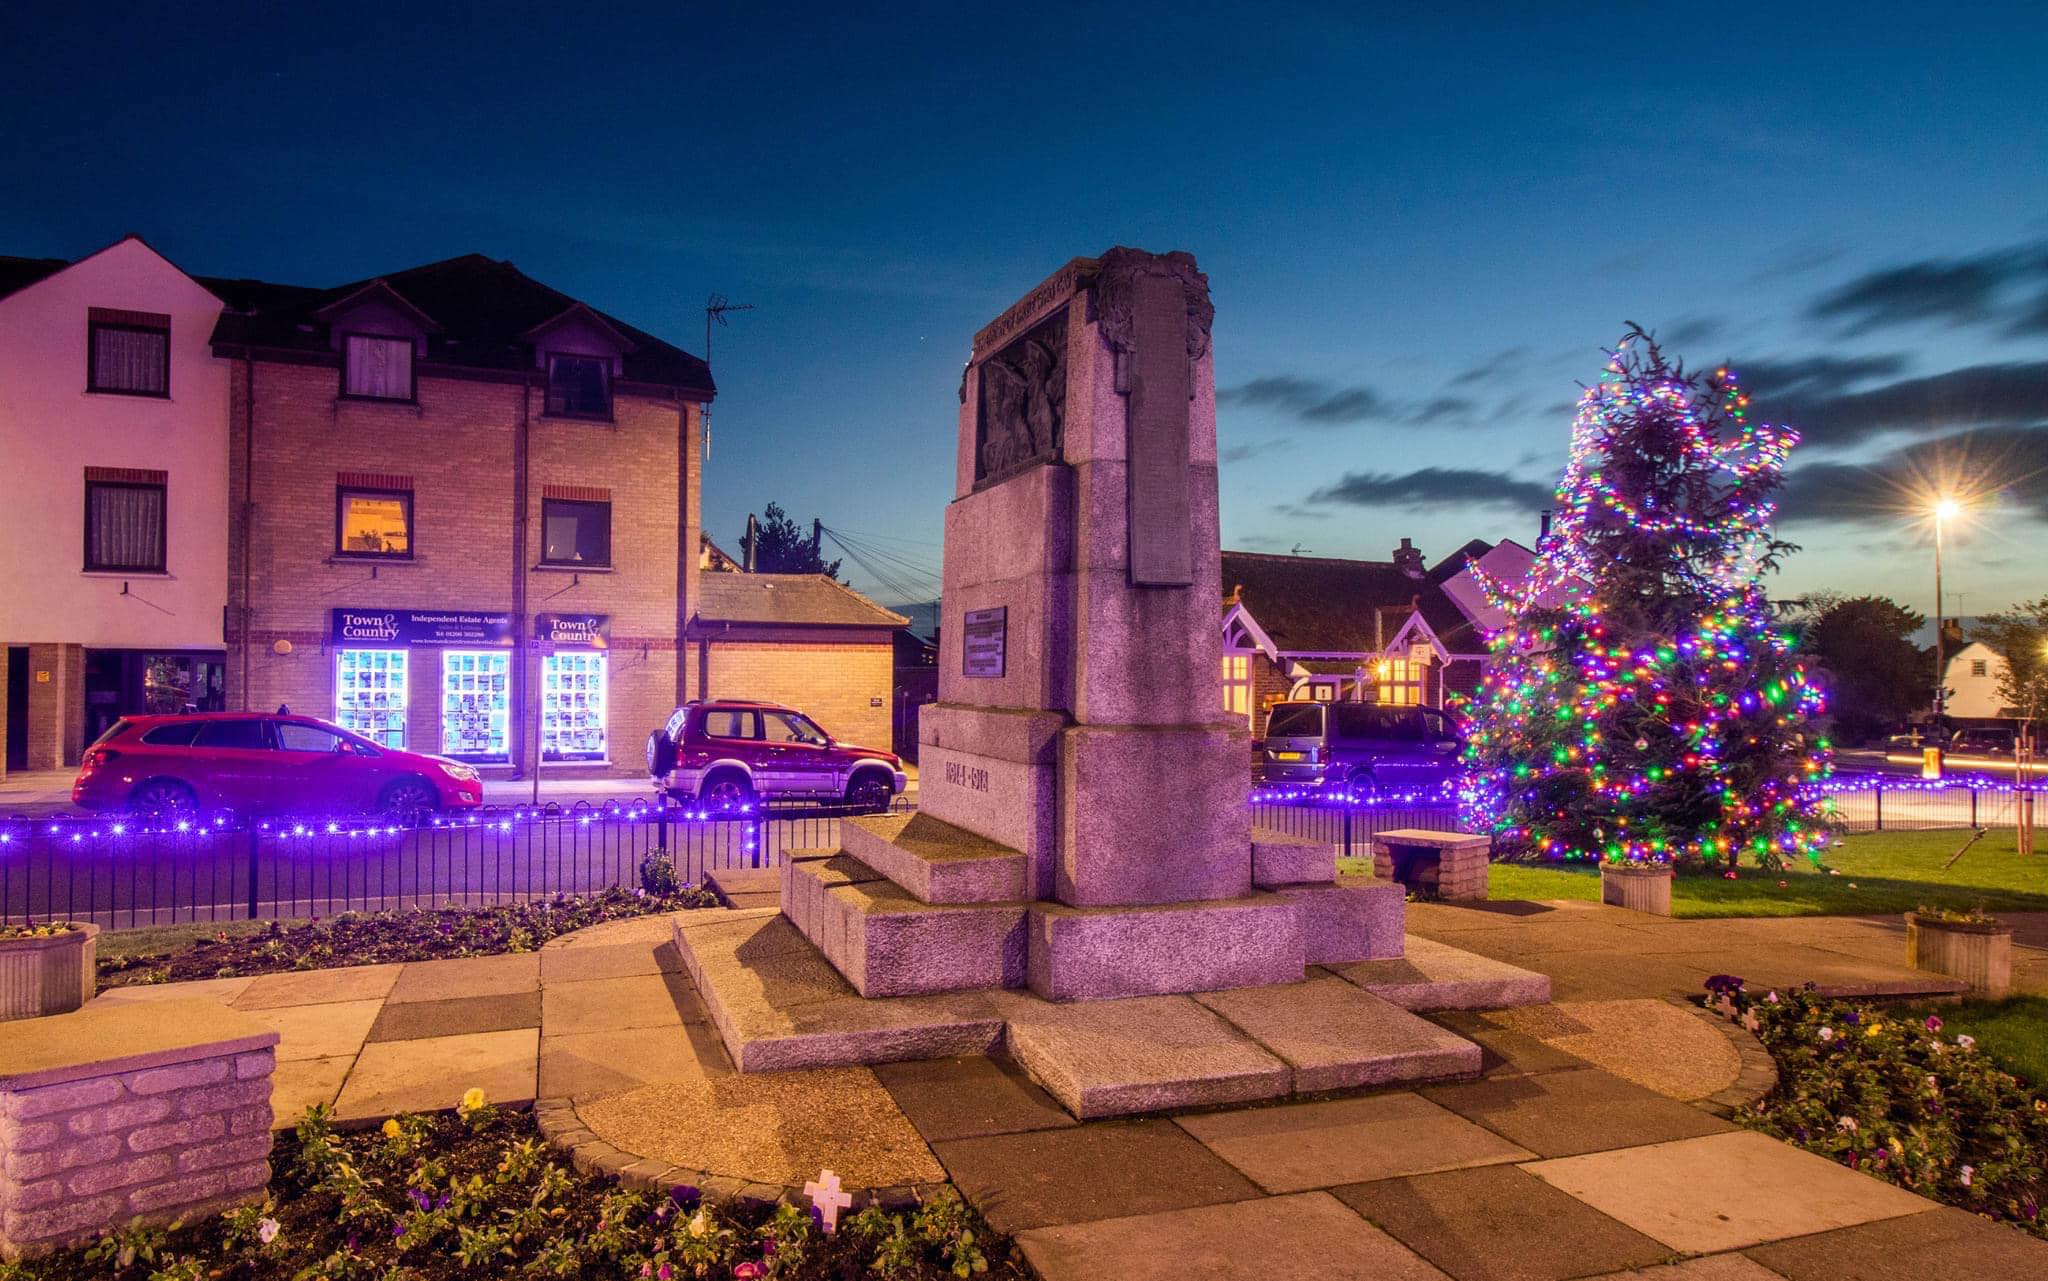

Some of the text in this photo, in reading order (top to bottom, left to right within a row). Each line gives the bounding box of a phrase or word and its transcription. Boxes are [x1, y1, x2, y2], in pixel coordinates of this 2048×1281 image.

[342, 613, 400, 631] Town &
[411, 614, 508, 625] Independent Estate Agents
[550, 618, 586, 631] Town
[343, 625, 400, 641] Country
